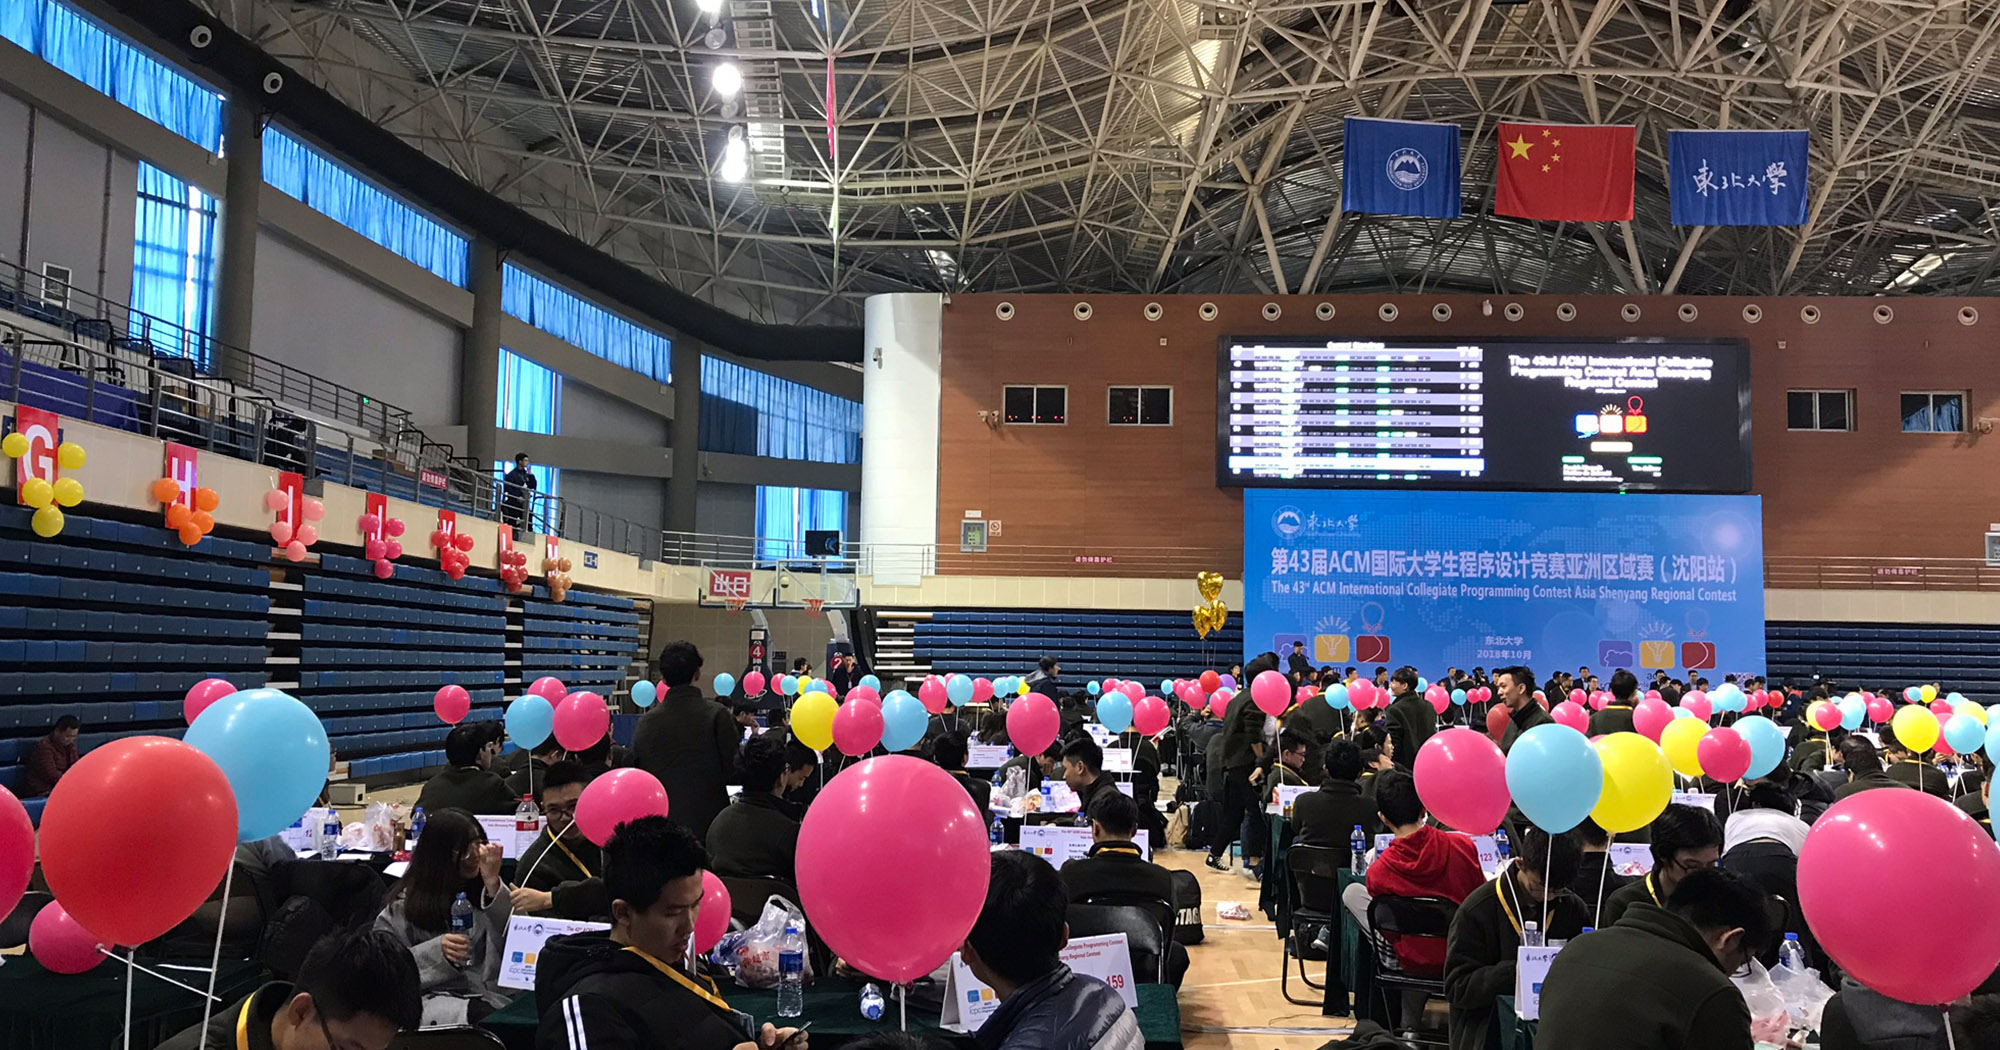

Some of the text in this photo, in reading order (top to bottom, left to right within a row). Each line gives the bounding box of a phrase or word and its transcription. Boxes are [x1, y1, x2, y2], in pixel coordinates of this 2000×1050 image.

[1508, 355, 1530, 366] The
[23, 424, 54, 485] G
[171, 457, 192, 510] H
[1271, 580, 1737, 604] The 43rd ACM International Collegiate Programming Contest Asia Shenyang Regional Contest
[1485, 635, 1524, 646] 东北大学
[752, 646, 762, 657] 4
[1477, 649, 1532, 660] 2018年10月
[1480, 853, 1493, 861] 123
[1083, 941, 1109, 949] Programming
[1105, 974, 1124, 989] 159
